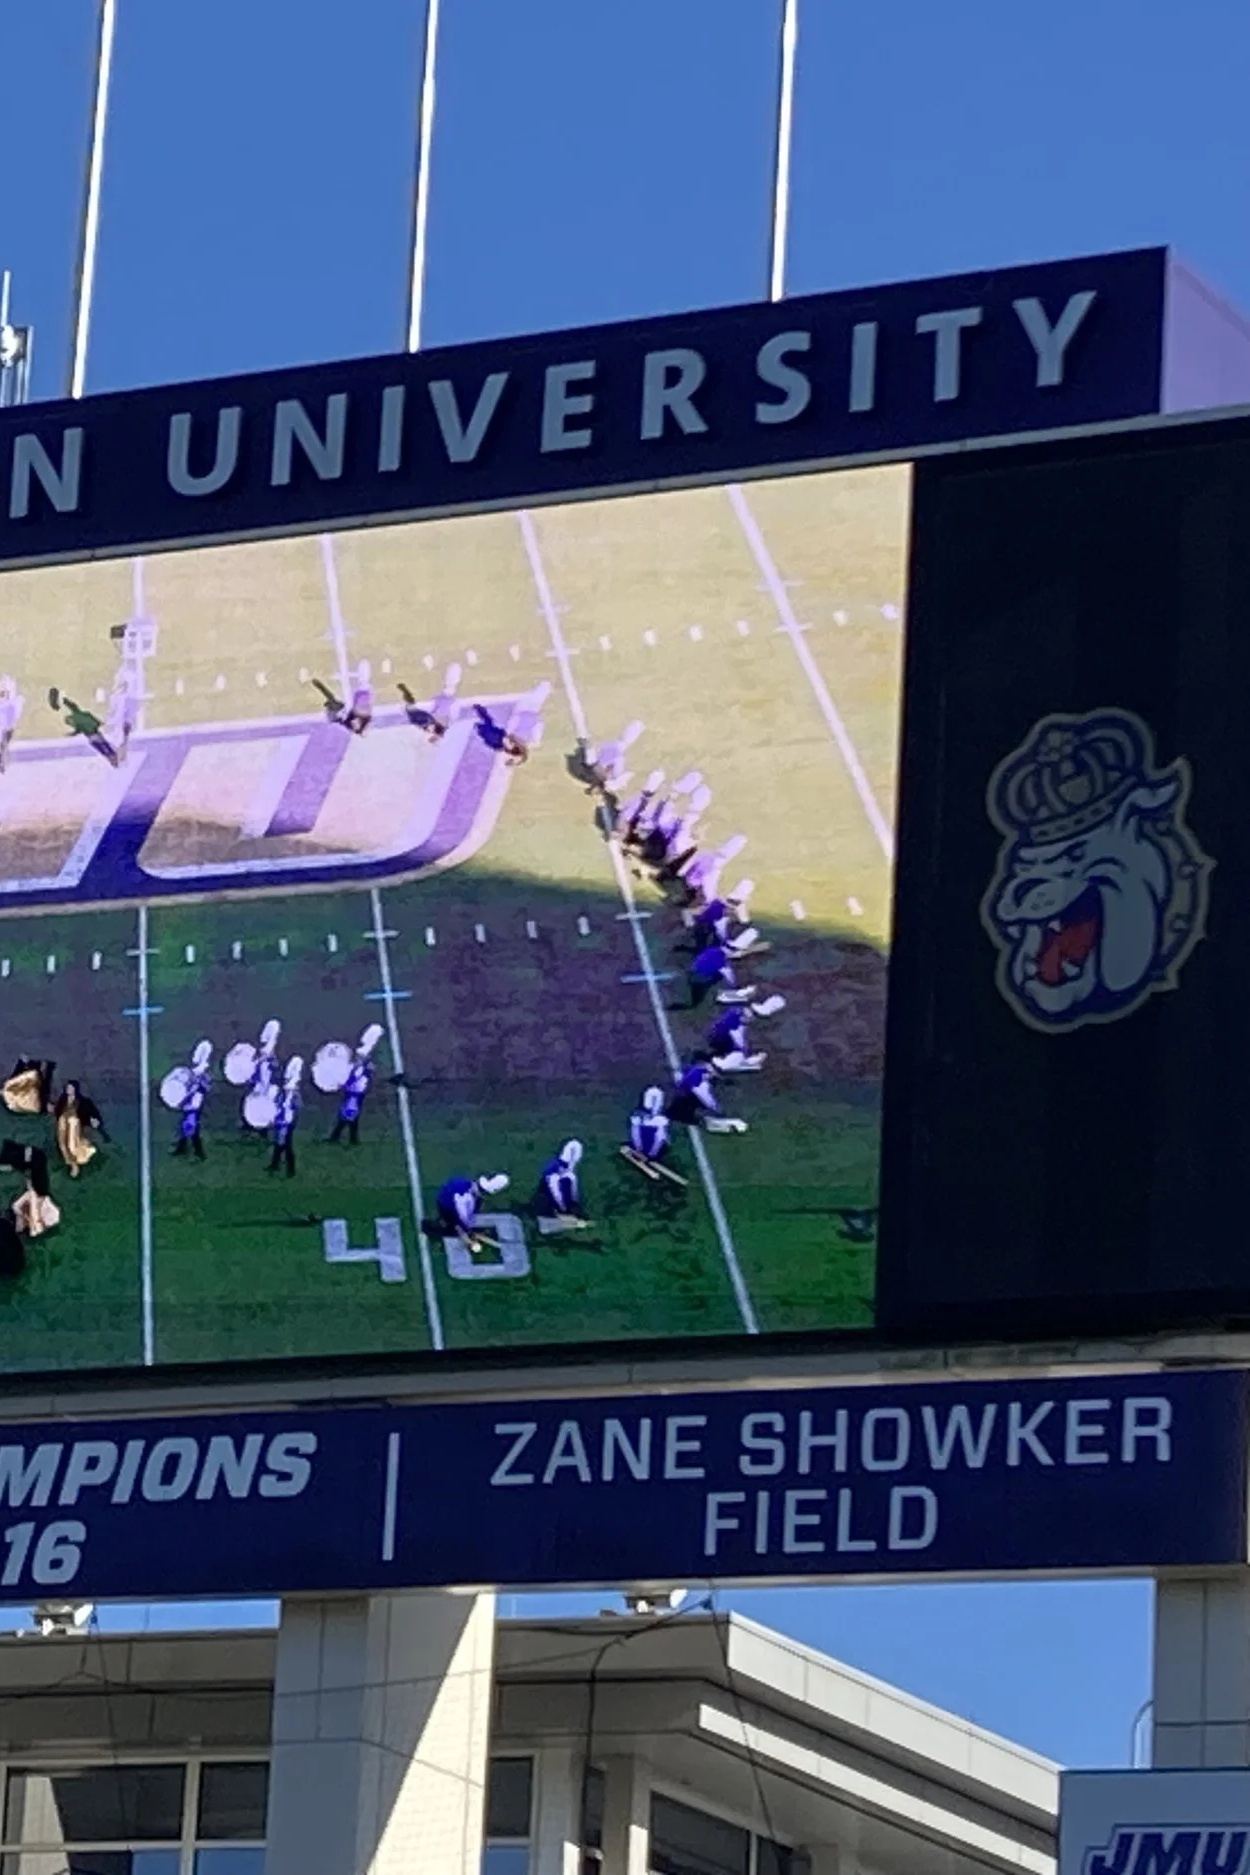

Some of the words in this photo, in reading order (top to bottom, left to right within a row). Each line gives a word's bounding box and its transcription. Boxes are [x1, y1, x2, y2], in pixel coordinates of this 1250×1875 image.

[166, 291, 1096, 498] UNIVERSITY
[323, 1213, 531, 1282] 40
[490, 1414, 708, 1486] ZANE
[739, 1396, 1172, 1476] SHOWKER
[703, 1485, 938, 1557] FIELD
[1088, 1829, 1250, 1875] JMU
